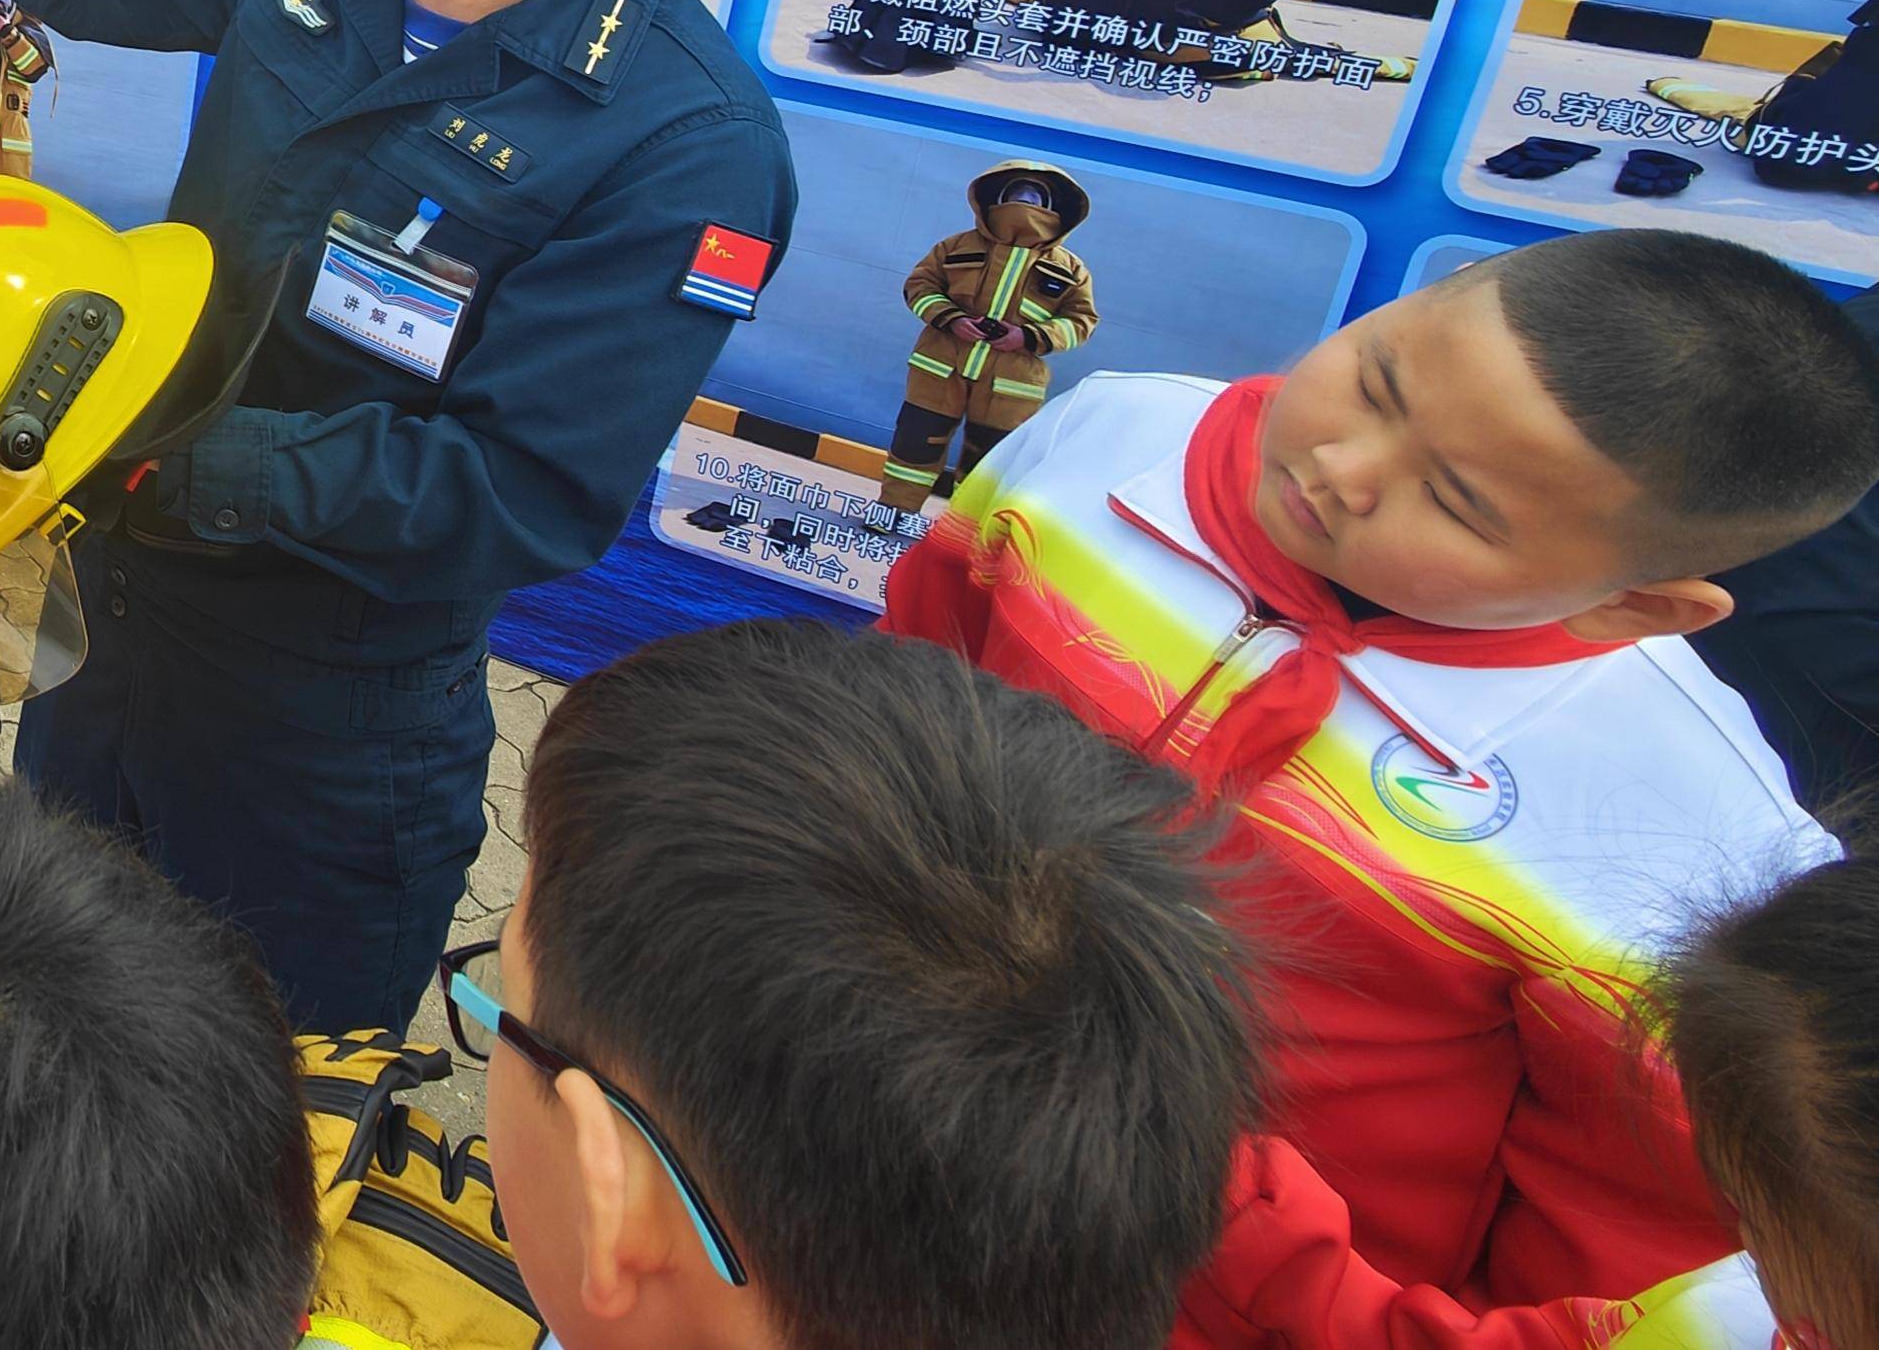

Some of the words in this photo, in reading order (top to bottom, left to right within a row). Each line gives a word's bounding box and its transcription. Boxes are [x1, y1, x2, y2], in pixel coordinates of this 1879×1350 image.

[342, 293, 416, 340] 讲解员
[695, 453, 934, 540] 10.将面巾下侧塞
[720, 524, 887, 599] 至下粘合，
